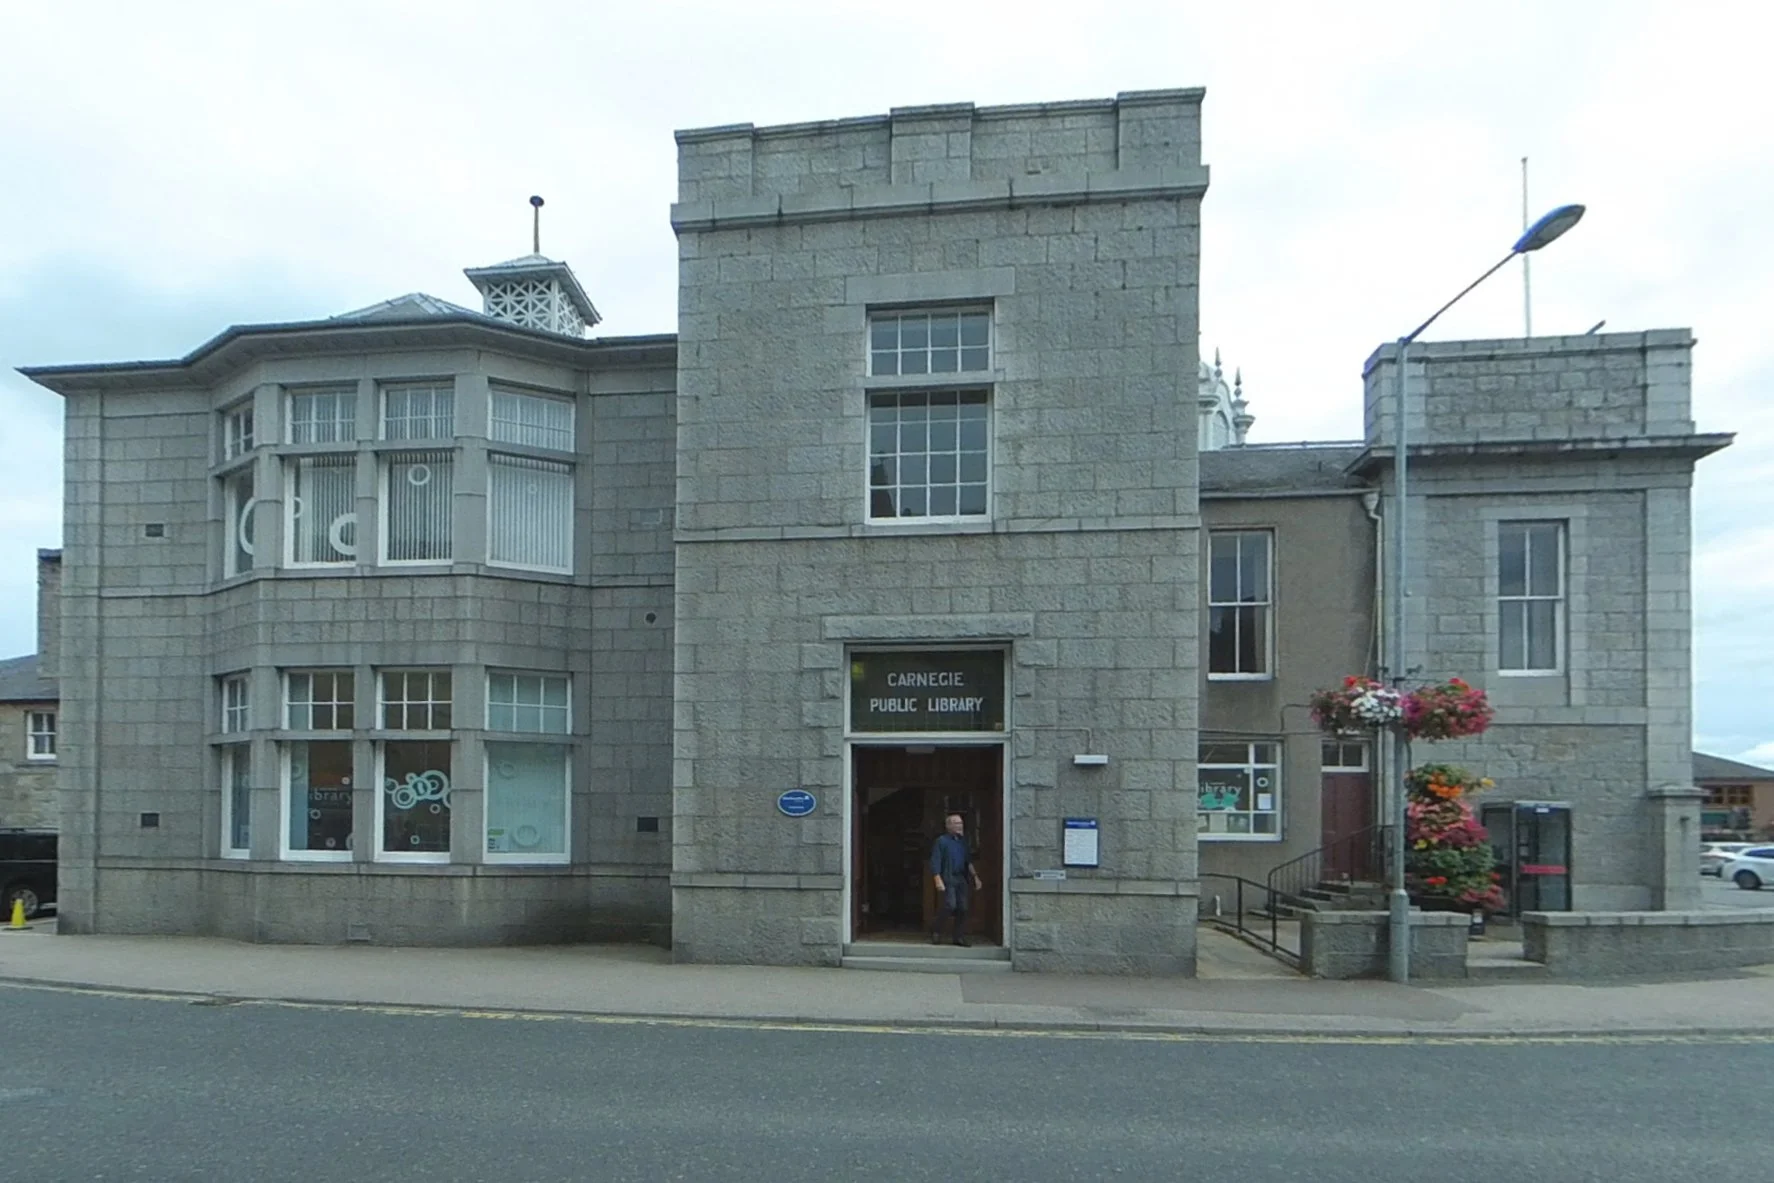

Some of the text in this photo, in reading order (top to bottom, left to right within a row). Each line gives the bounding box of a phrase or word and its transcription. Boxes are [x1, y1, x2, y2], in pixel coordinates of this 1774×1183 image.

[887, 672, 964, 687] CARNEGIE
[870, 697, 983, 712] PUBLIC LIBRARY
[309, 787, 351, 805] ibrary
[1200, 781, 1242, 799] ibrary
